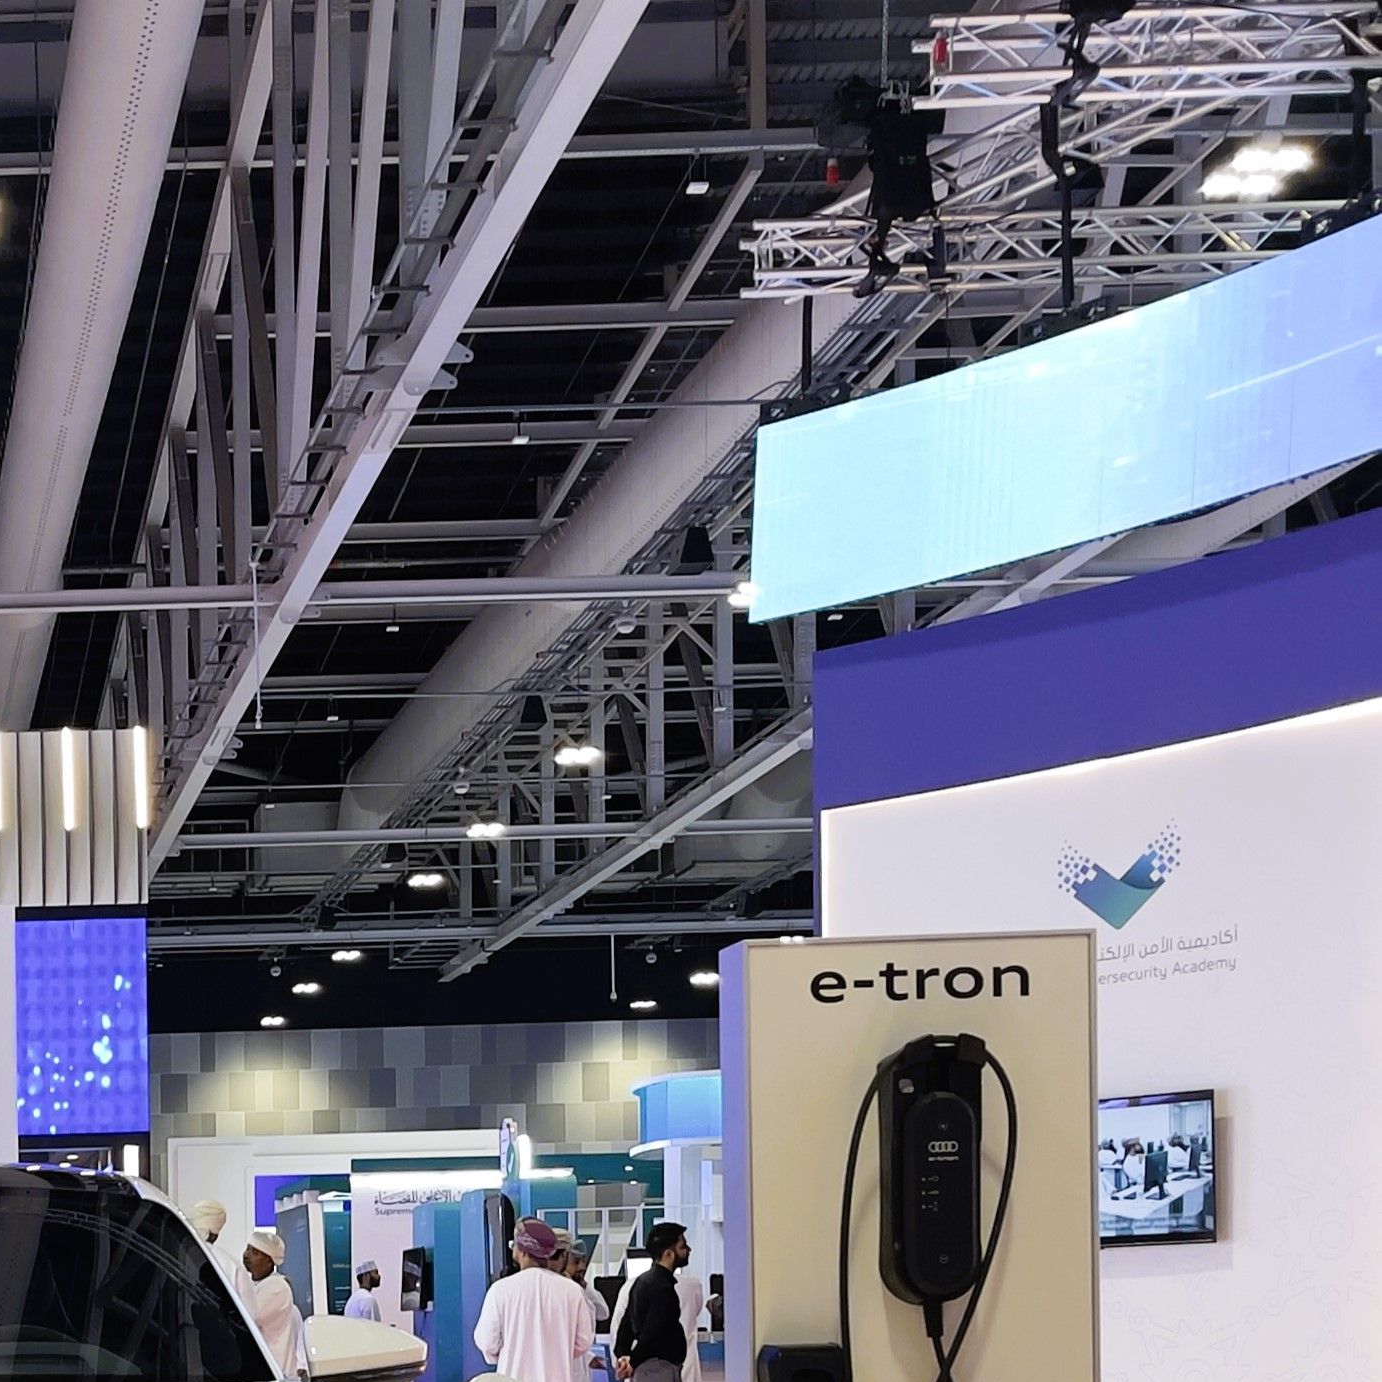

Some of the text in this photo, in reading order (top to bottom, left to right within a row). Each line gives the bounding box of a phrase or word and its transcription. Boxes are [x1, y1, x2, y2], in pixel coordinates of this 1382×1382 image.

[1138, 936, 1173, 959] الأمن
[1177, 923, 1238, 952] أكاديمية
[810, 962, 1030, 1003] e-tron
[1098, 957, 1237, 985] ersecurity Academy
[374, 1206, 413, 1216] Suprem
